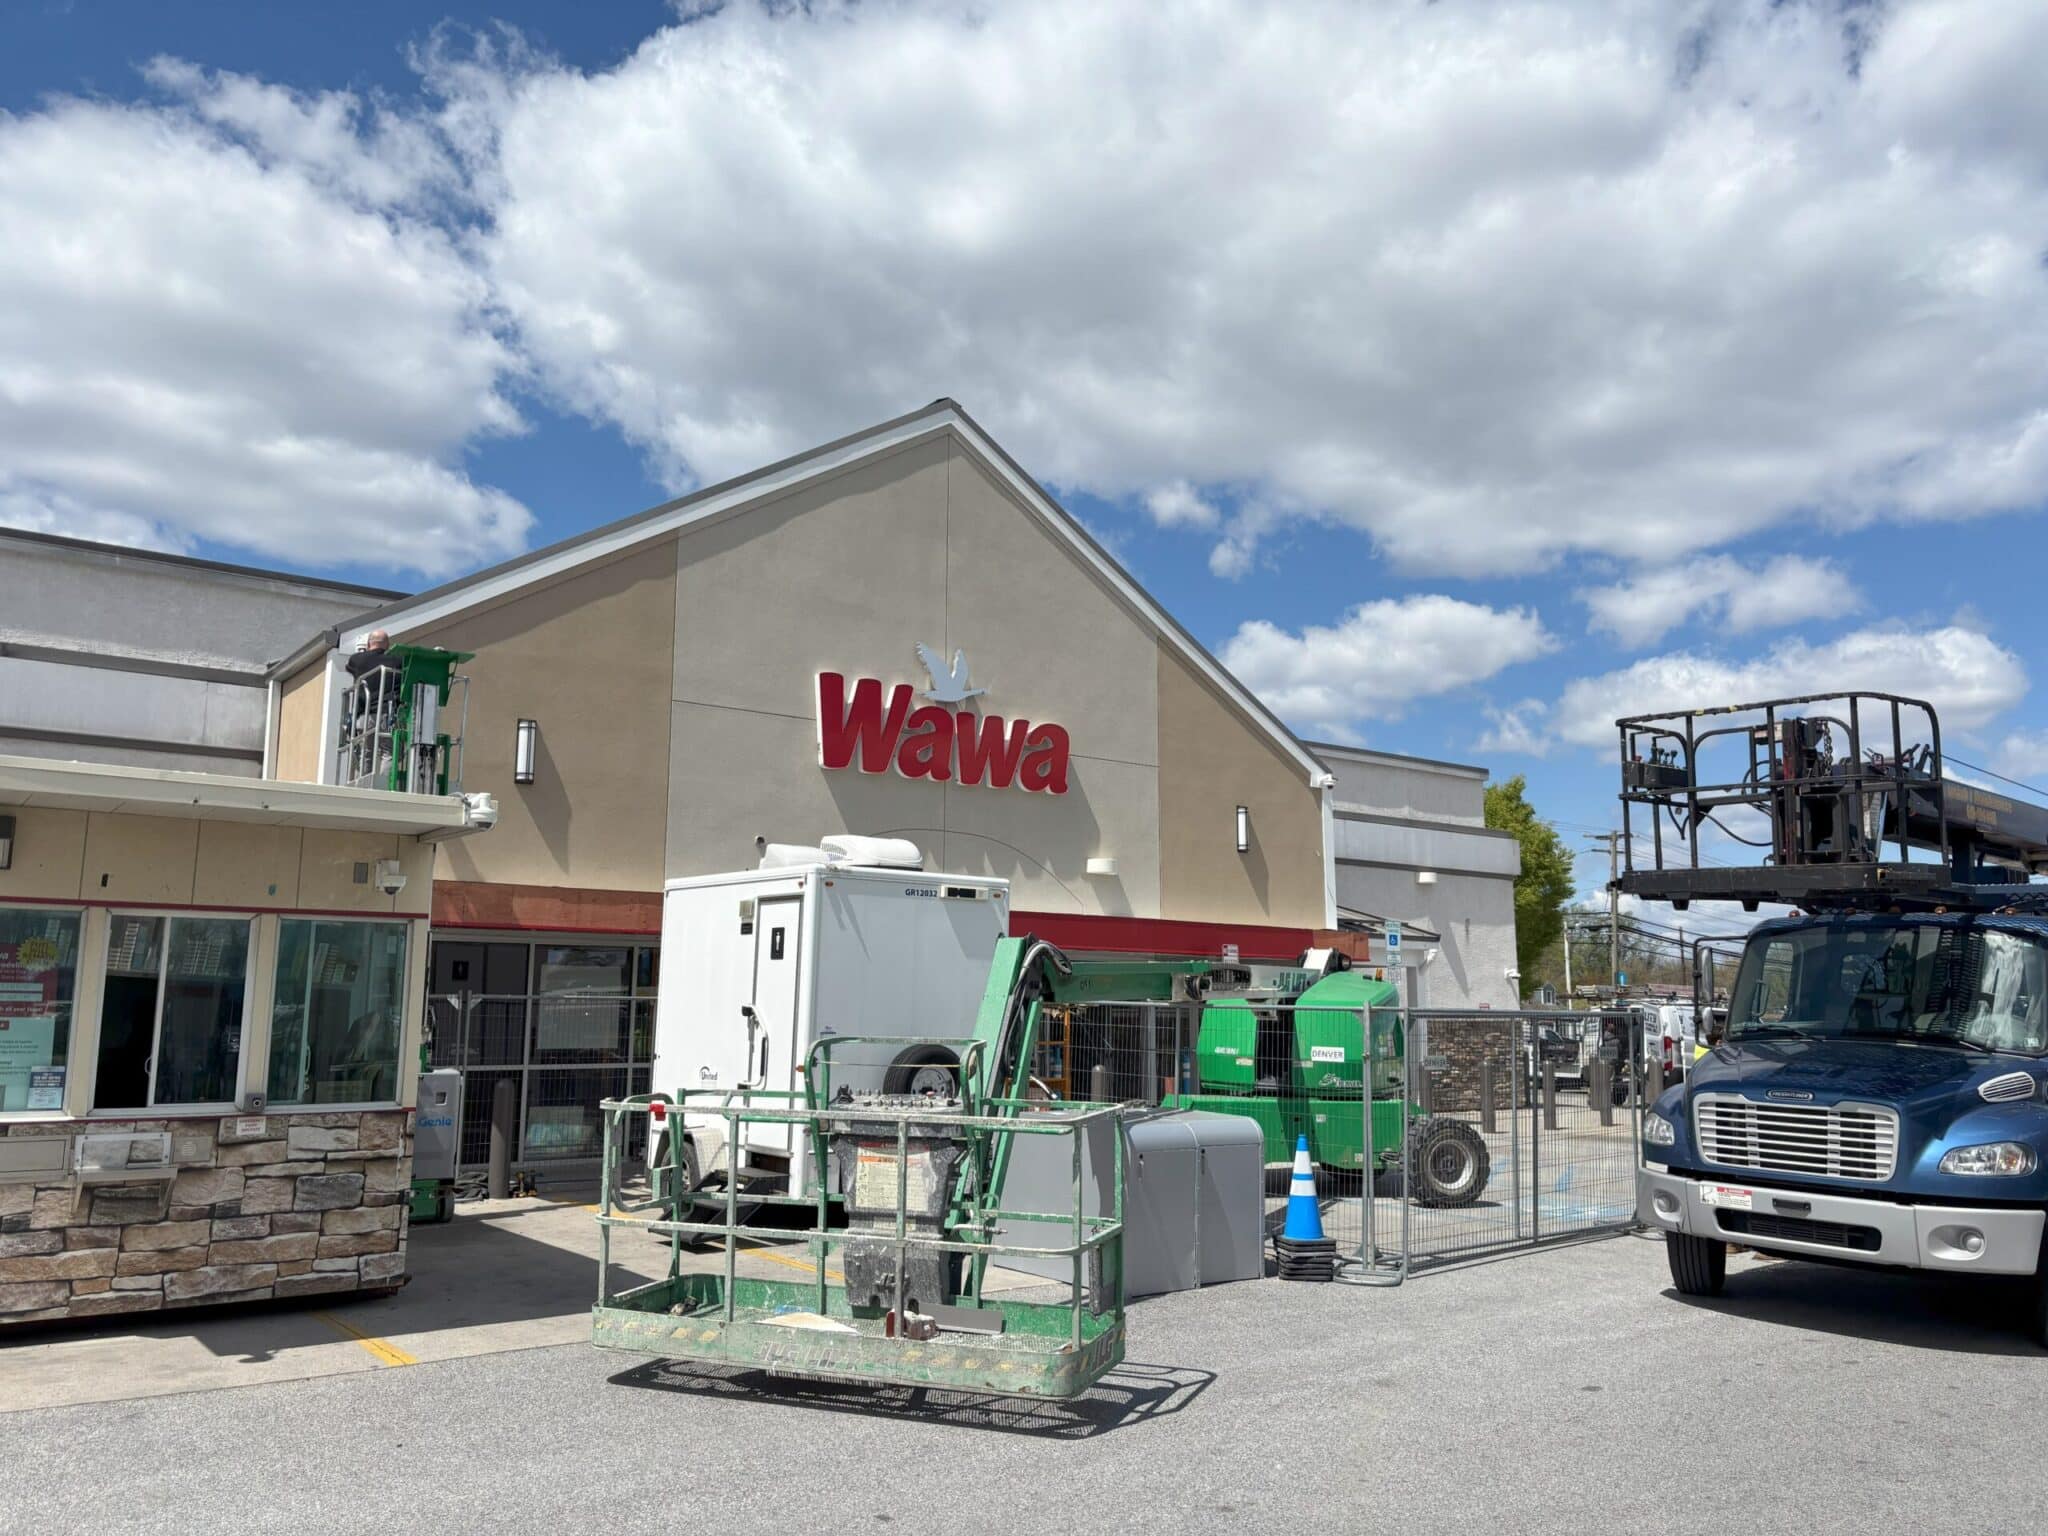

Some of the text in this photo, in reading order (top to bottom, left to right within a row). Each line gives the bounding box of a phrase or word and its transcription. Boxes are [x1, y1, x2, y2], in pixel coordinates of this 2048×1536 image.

[815, 671, 1070, 795] Wawa
[905, 888, 938, 897] GR12032
[1312, 1050, 1344, 1059] DENVER
[418, 1116, 452, 1127] Genie
